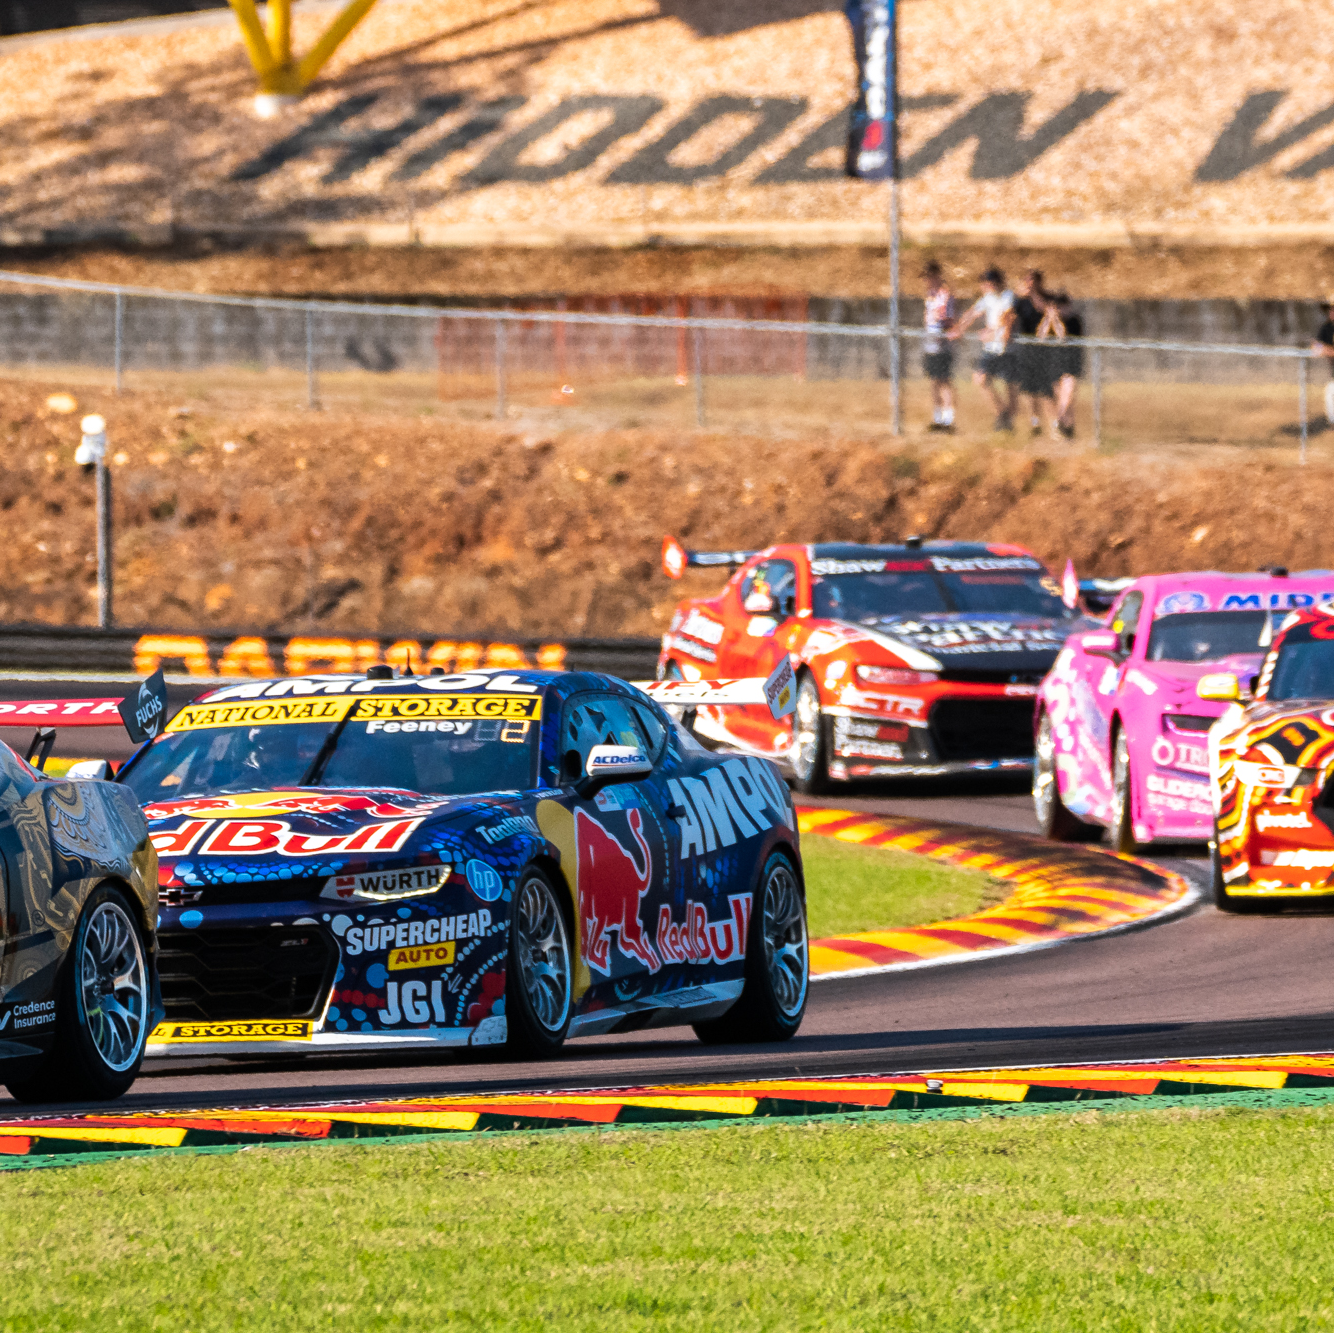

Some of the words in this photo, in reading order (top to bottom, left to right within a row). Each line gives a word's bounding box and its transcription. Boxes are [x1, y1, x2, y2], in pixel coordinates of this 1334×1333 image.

[811, 559, 887, 575] Shaw
[133, 634, 566, 676] DARWIN
[202, 672, 539, 703] AMPOL
[137, 695, 163, 728] FUCHS
[179, 701, 339, 729] NATIONAL
[356, 698, 530, 717] STORAGE
[366, 720, 472, 735] Feeney
[501, 720, 530, 743] 2
[593, 754, 646, 764] ACDelco
[667, 757, 794, 859] AMPOL
[198, 817, 427, 856] Bull
[473, 866, 495, 895] hp
[346, 909, 492, 955] SUPERCHEAP
[395, 948, 448, 965] AUTO
[13, 999, 56, 1017] Credence
[378, 980, 446, 1024] JGI
[14, 1011, 56, 1029] Insurance
[180, 1023, 303, 1037] STORAGE
